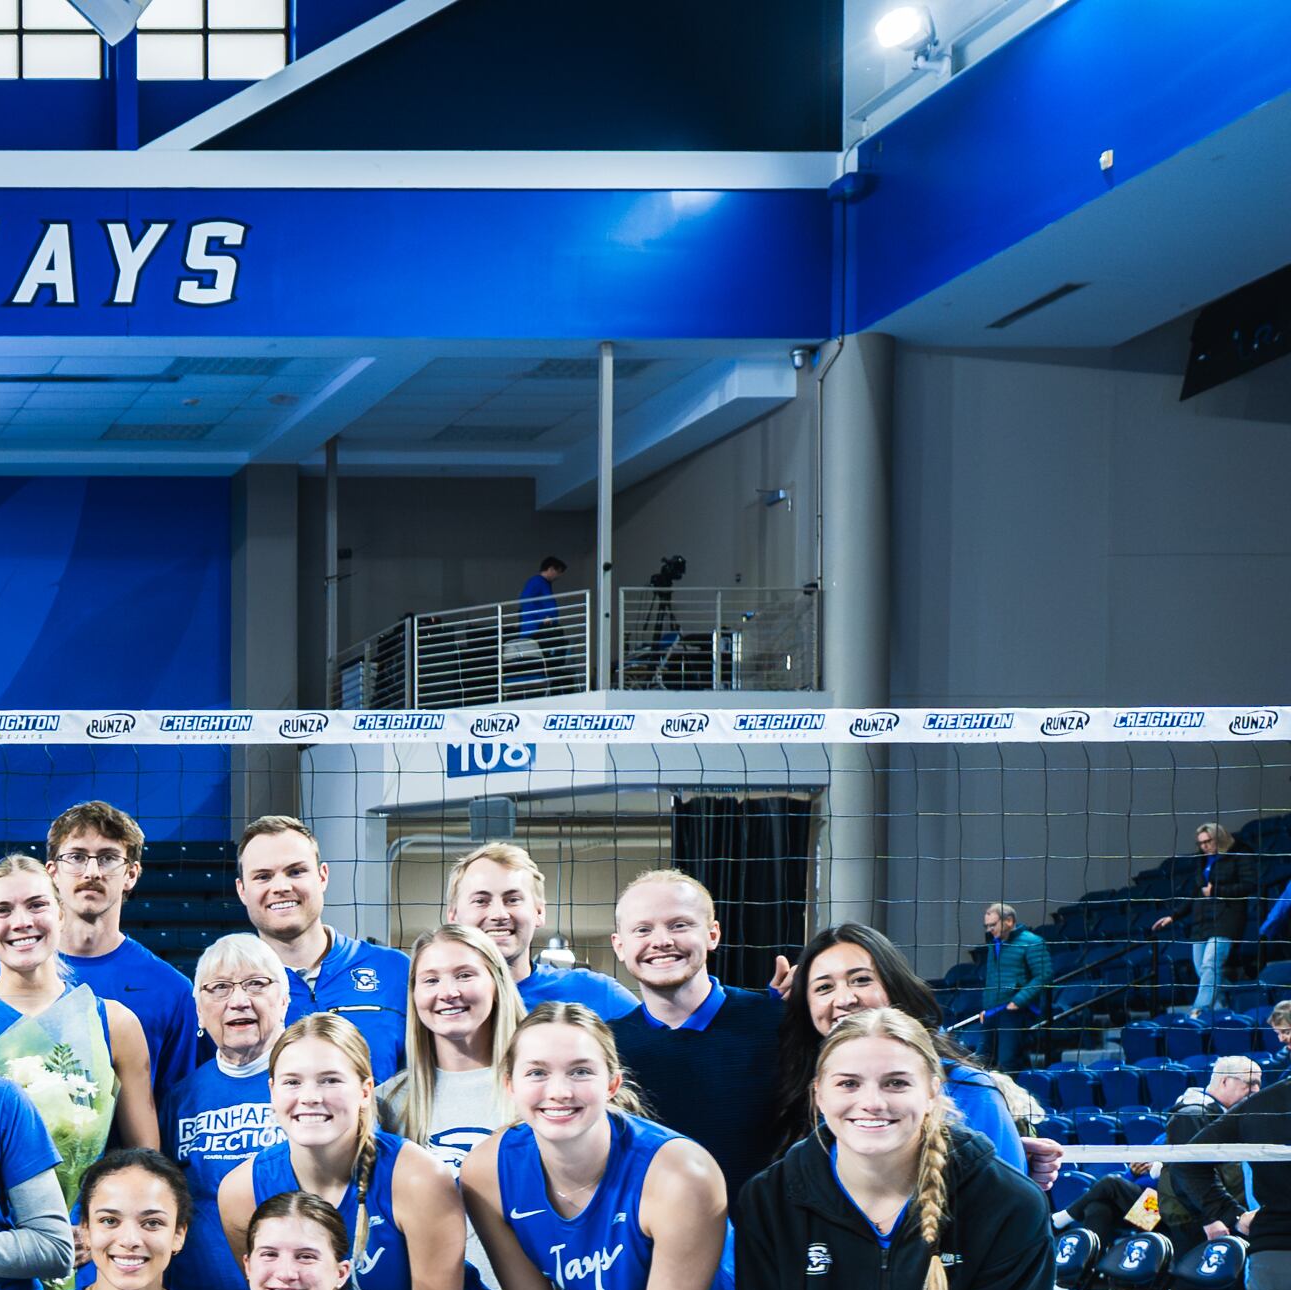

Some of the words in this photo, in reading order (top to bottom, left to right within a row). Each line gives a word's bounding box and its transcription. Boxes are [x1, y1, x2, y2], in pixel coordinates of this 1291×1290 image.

[90, 718, 132, 733] RUNZA
[160, 716, 253, 731] CREIGHTON
[283, 718, 325, 733] RUNZA
[353, 715, 445, 730] CREIGHTON
[474, 718, 516, 732] RUNZA
[543, 715, 635, 730] CREIGHTON
[665, 717, 705, 732] RUNZA
[733, 714, 825, 729] CREIGHTON
[853, 717, 895, 731] RUNZA
[923, 713, 1014, 728] CREIGHTON
[1044, 716, 1086, 731] RUNZA
[1113, 712, 1204, 727] CREIGHTON
[1233, 716, 1274, 730] RUNZA
[452, 743, 532, 771] 108
